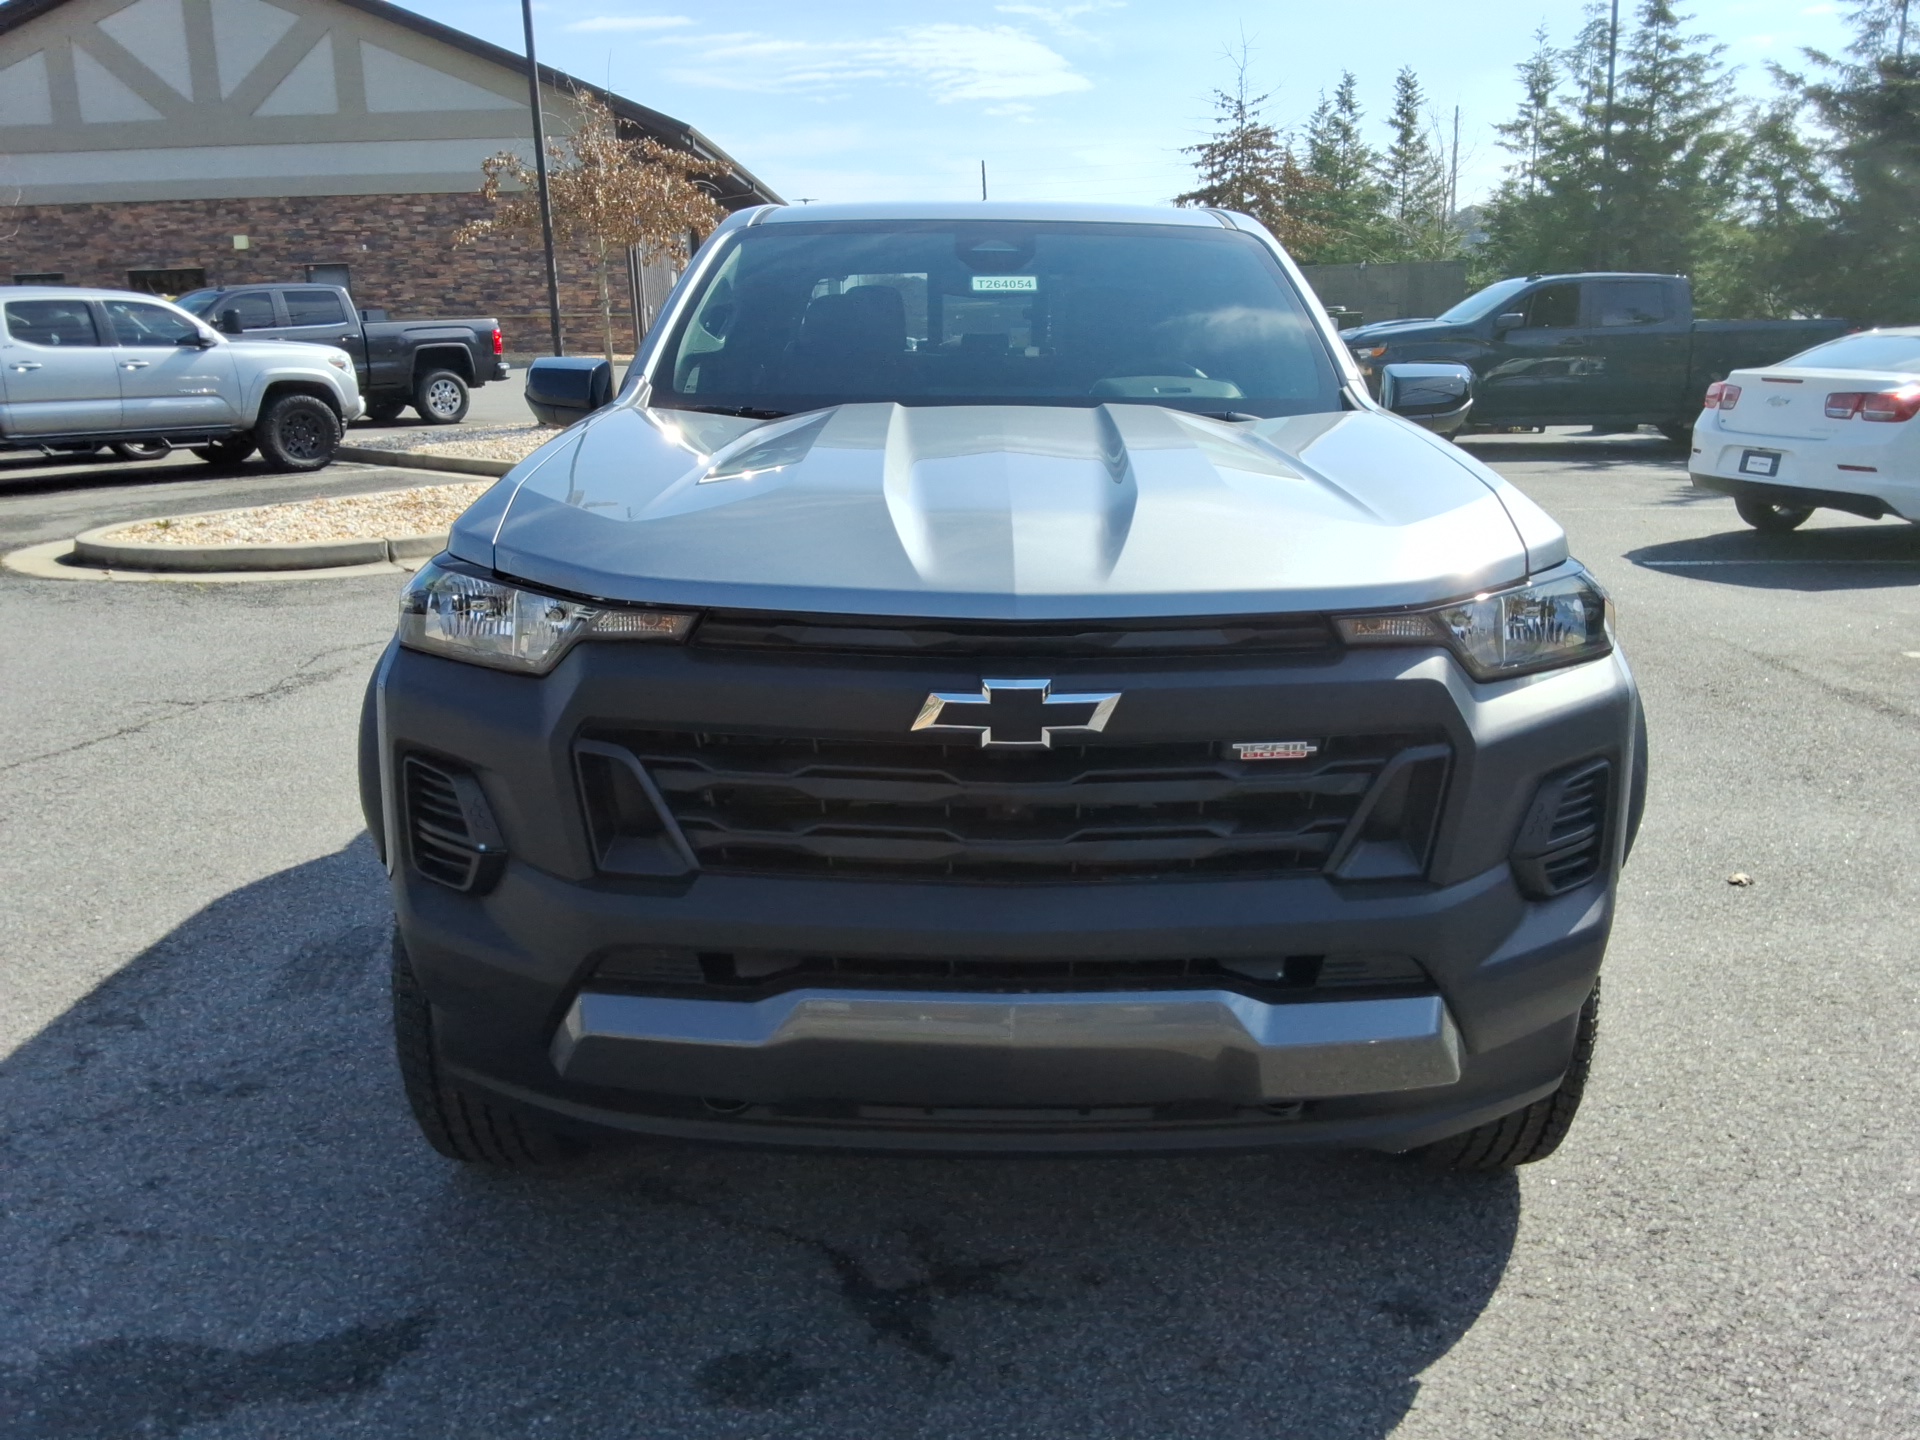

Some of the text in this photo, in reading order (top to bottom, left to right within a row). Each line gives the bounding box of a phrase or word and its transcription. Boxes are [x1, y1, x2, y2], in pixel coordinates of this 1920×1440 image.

[976, 279, 1033, 289] T264054
[1232, 741, 1317, 752] TRAIL
[1240, 751, 1307, 759] BOSS
